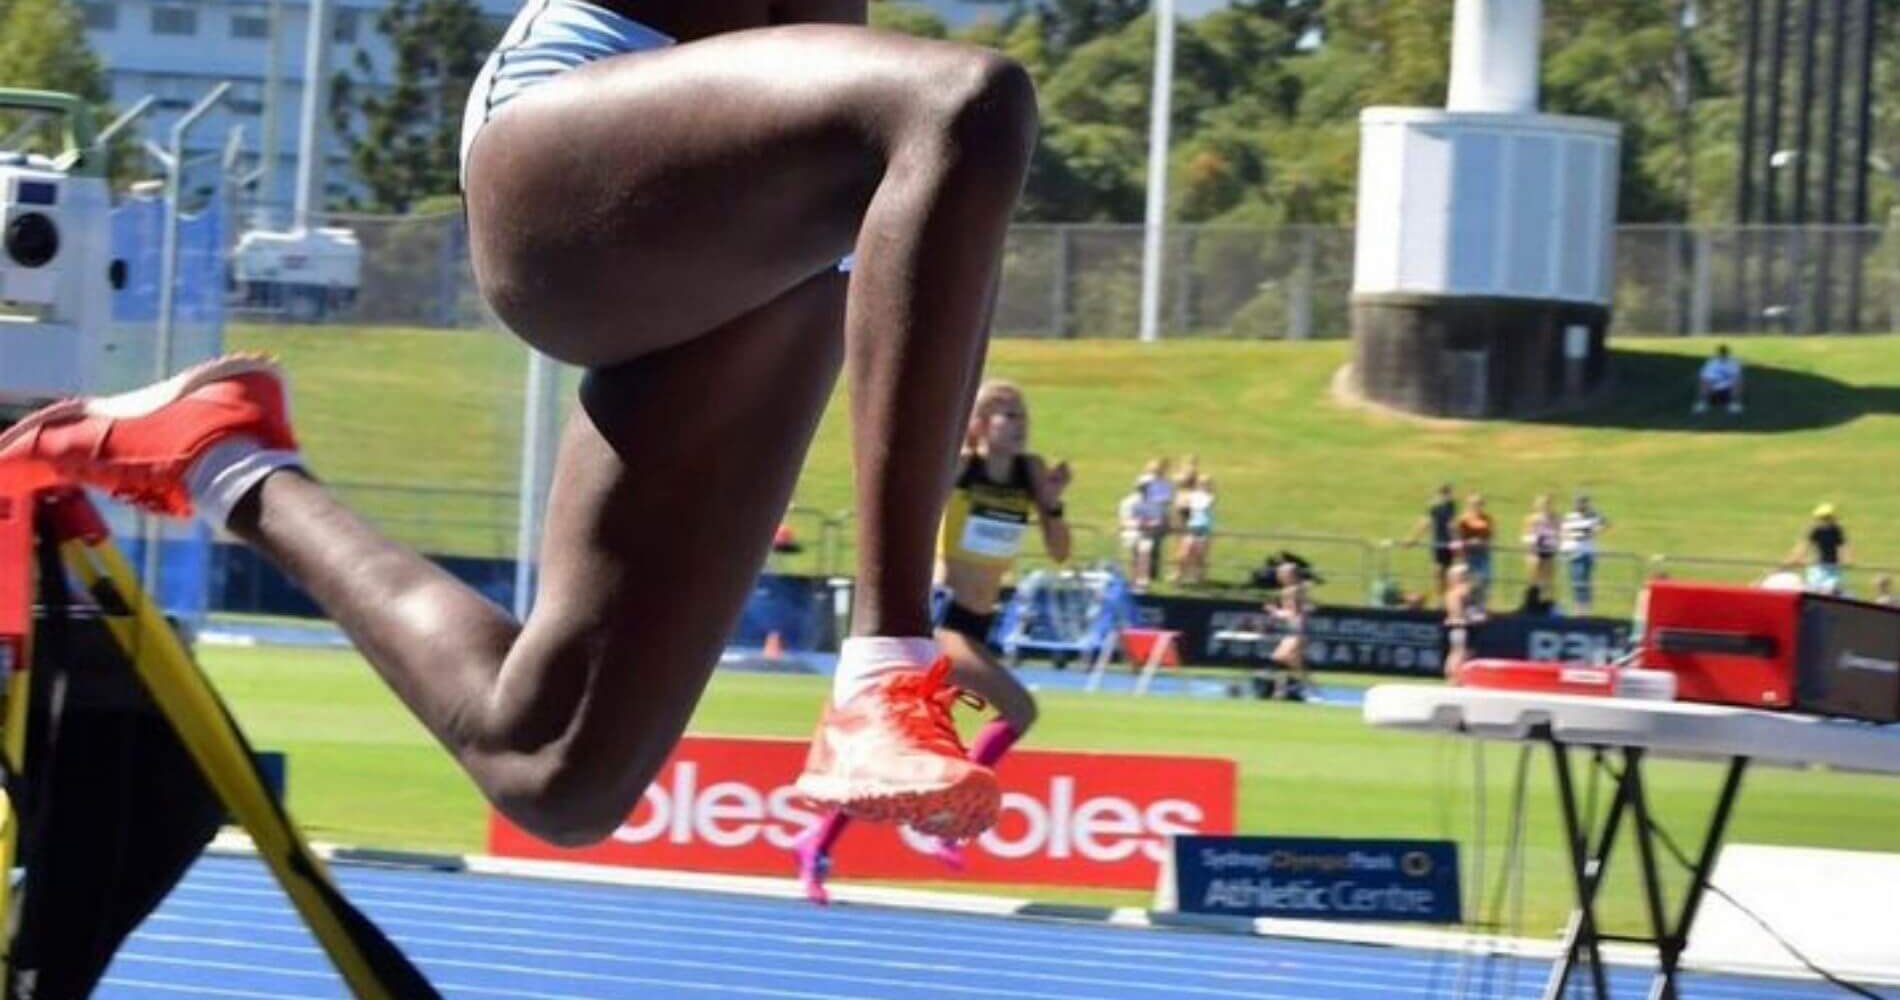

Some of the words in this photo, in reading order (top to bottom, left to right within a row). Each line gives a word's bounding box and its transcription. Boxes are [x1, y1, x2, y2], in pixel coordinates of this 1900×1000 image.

[612, 761, 823, 849] oles
[1204, 879, 1329, 911] Athletic
[1330, 881, 1436, 914] Centre
